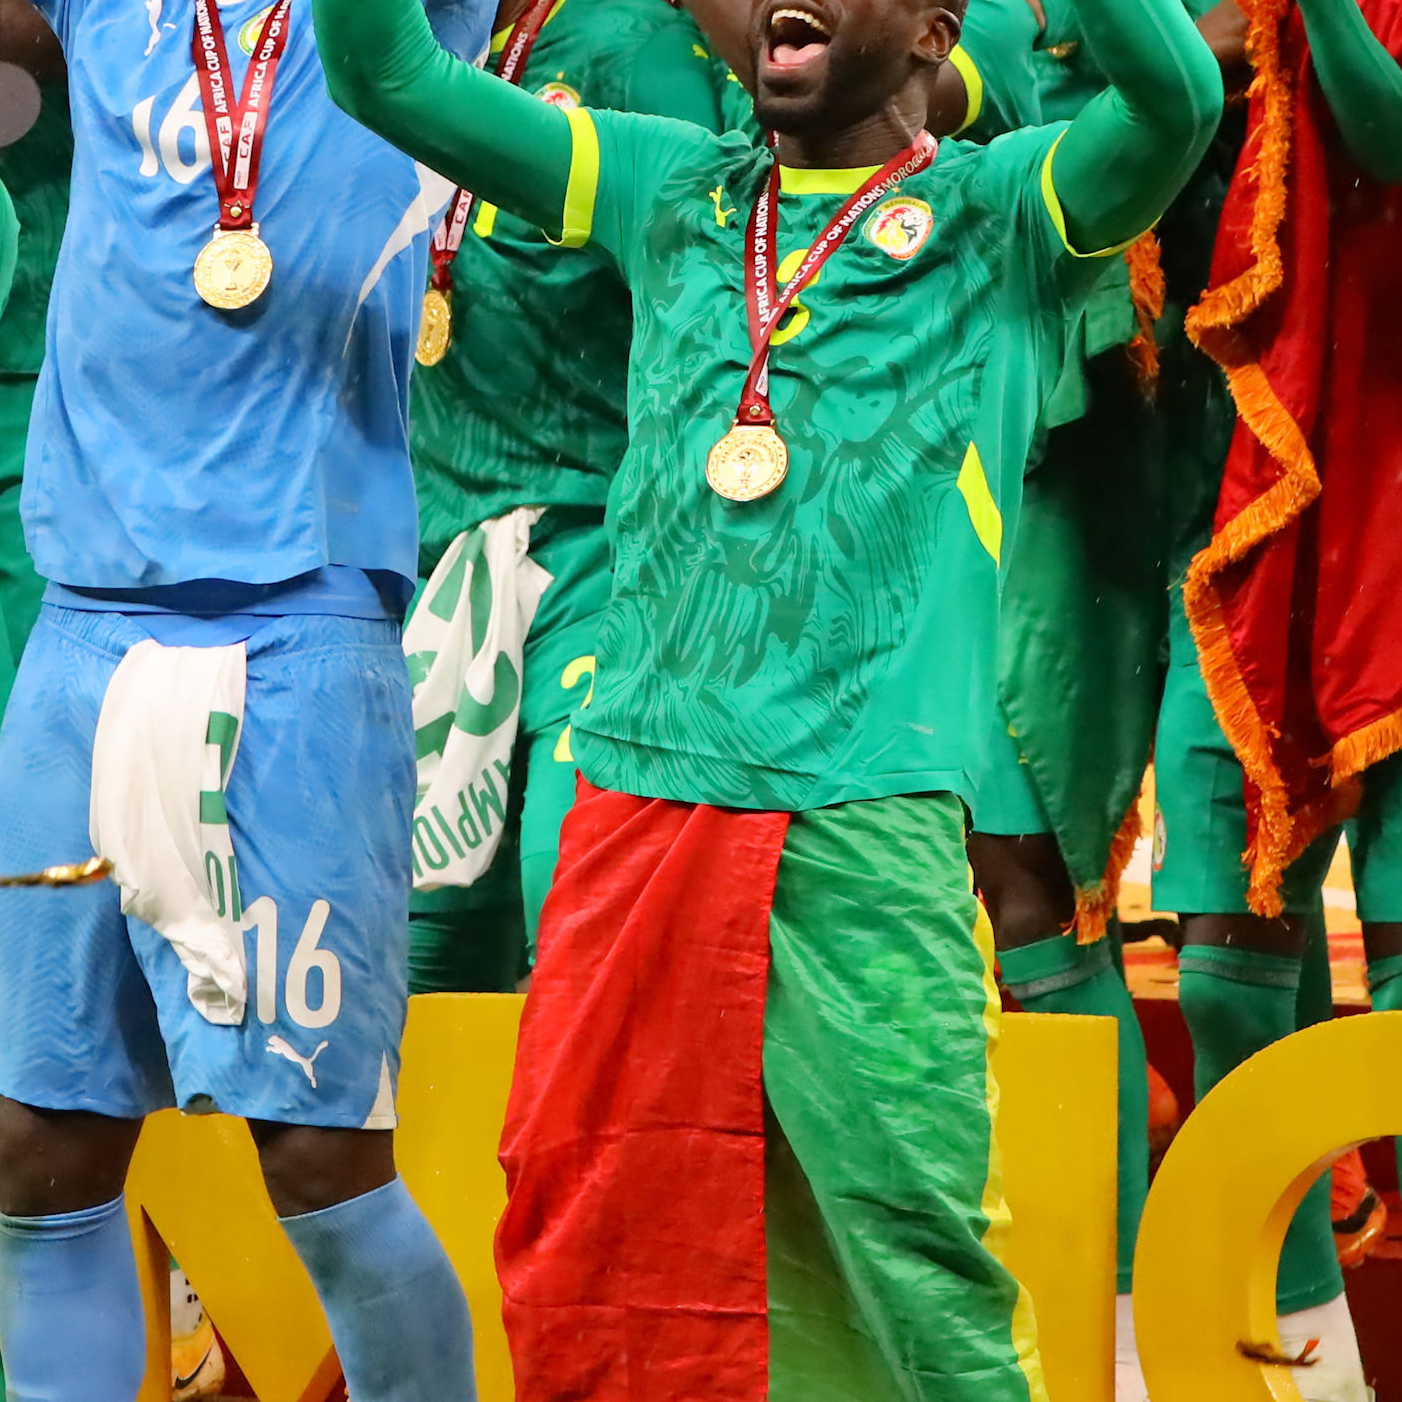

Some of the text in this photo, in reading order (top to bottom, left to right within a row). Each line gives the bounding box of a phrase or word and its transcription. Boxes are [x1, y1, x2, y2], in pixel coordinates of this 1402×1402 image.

[201, 33, 216, 51] OF
[204, 50, 221, 73] CUP
[248, 60, 269, 108] AFRICA
[259, 38, 277, 61] CUP
[268, 19, 283, 38] OF
[132, 70, 214, 185] 16
[211, 71, 228, 114] AFRICA
[239, 121, 252, 159] CAF
[755, 192, 769, 324] AFRICA CUP OF NATIONS
[779, 263, 809, 304] AFRICA
[807, 241, 828, 266] CUP
[826, 224, 844, 241] OF
[840, 186, 886, 229] NATIONS
[242, 895, 342, 1029] 16
